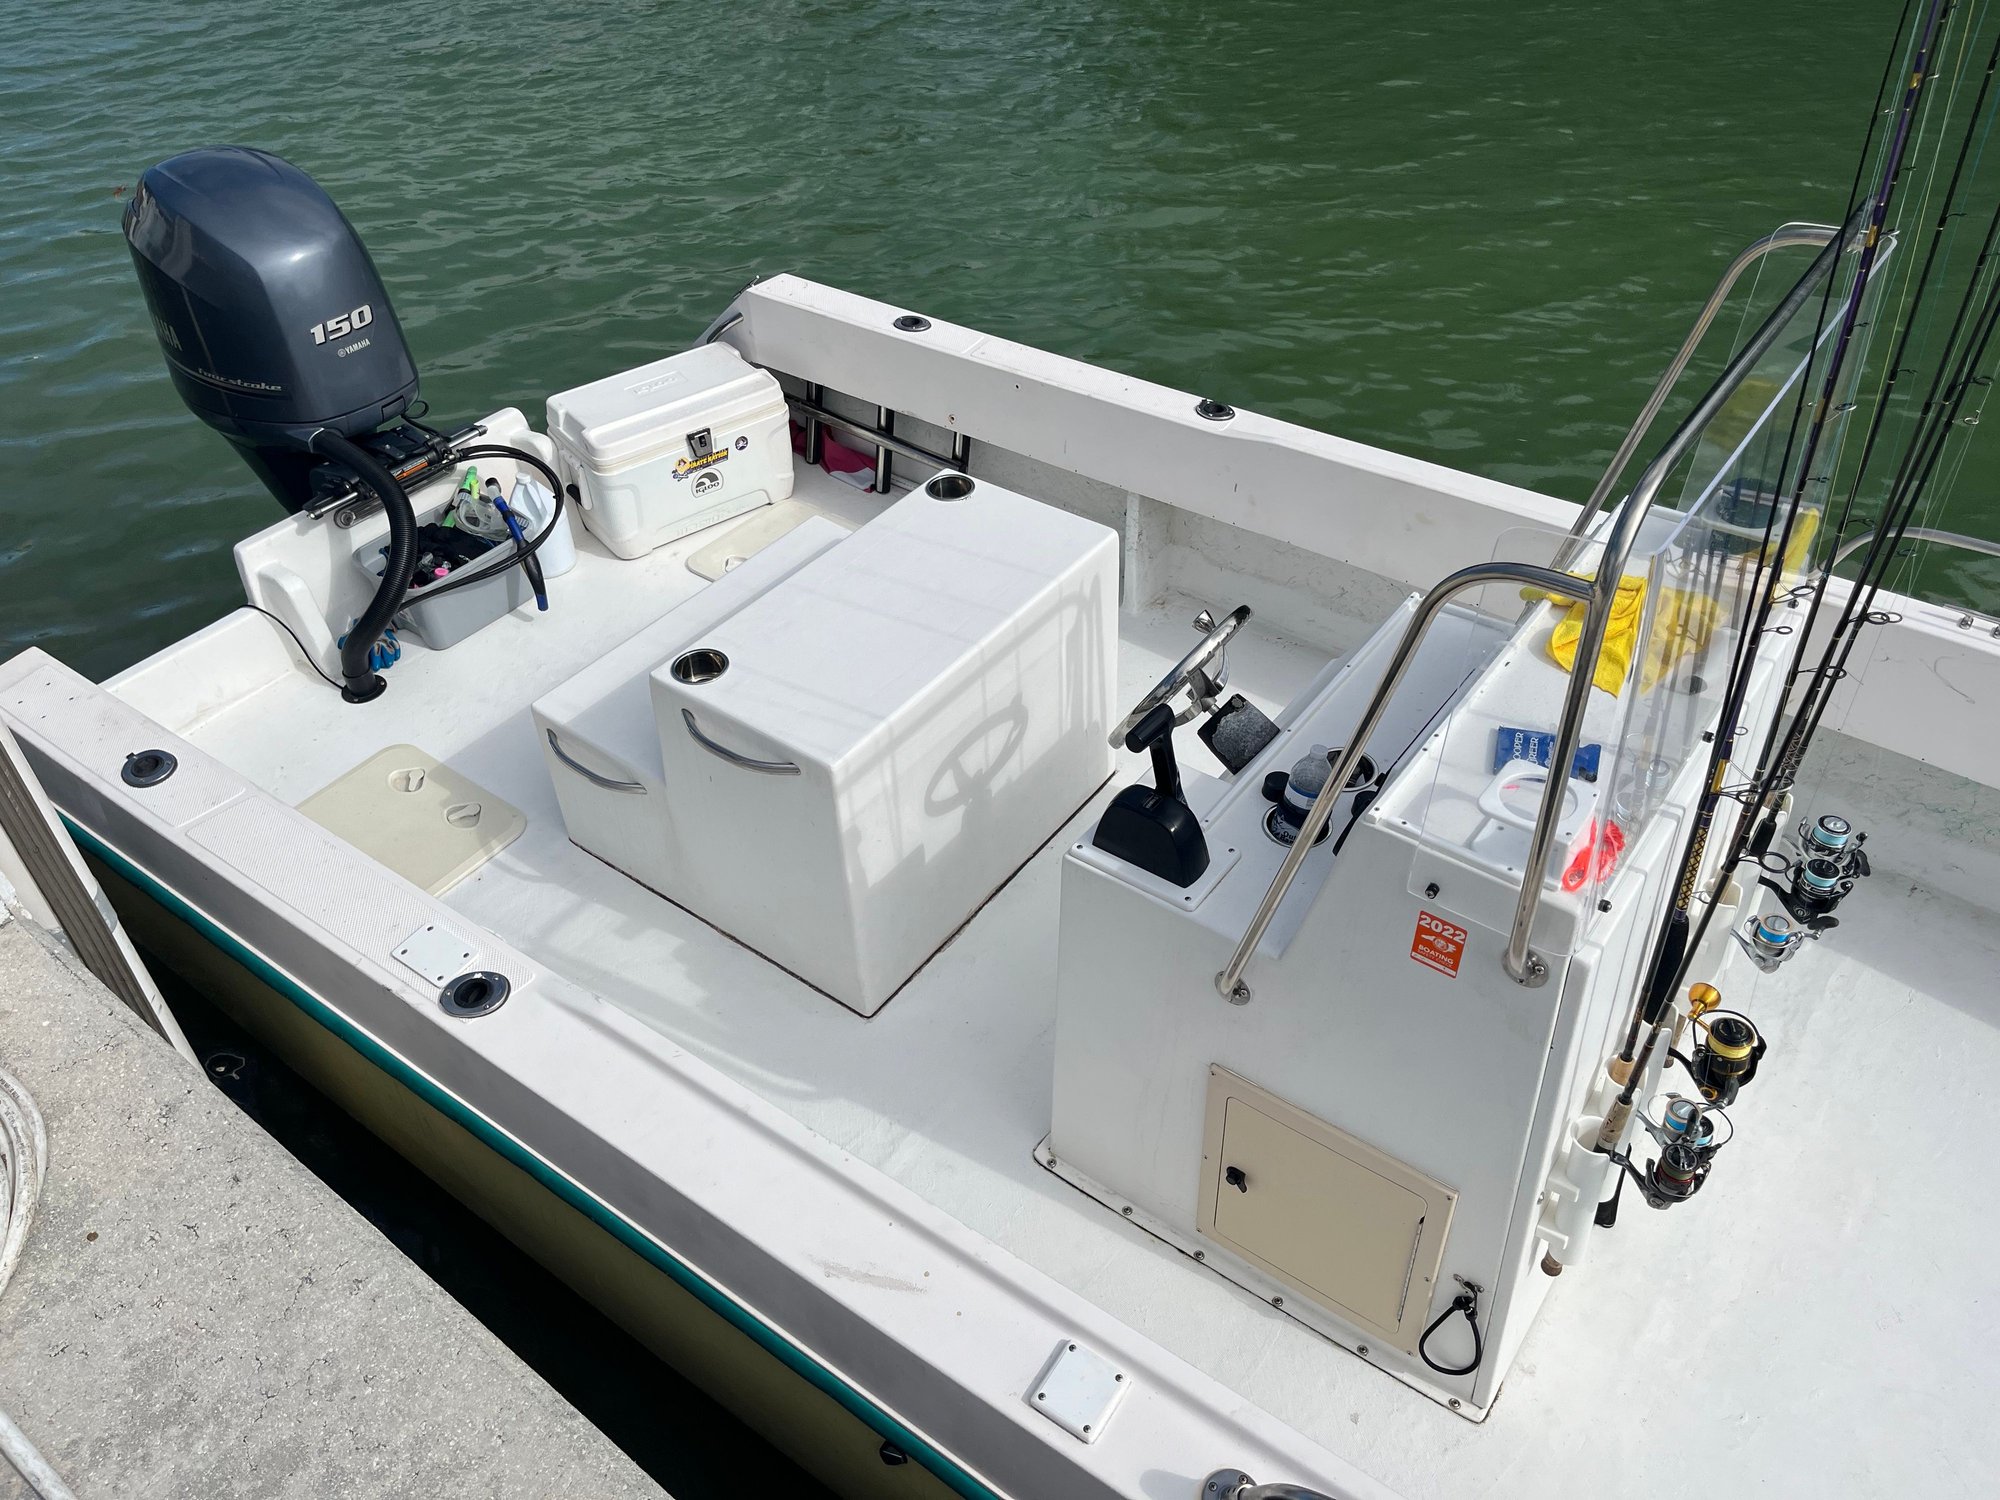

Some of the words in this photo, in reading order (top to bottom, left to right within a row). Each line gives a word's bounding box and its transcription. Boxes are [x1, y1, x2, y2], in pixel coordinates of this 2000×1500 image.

[310, 304, 373, 345] 150
[344, 338, 371, 355] YAMAHA
[1513, 732, 1524, 760] OOPER
[1419, 914, 1466, 944] 2022
[1418, 944, 1454, 965] BOATING
